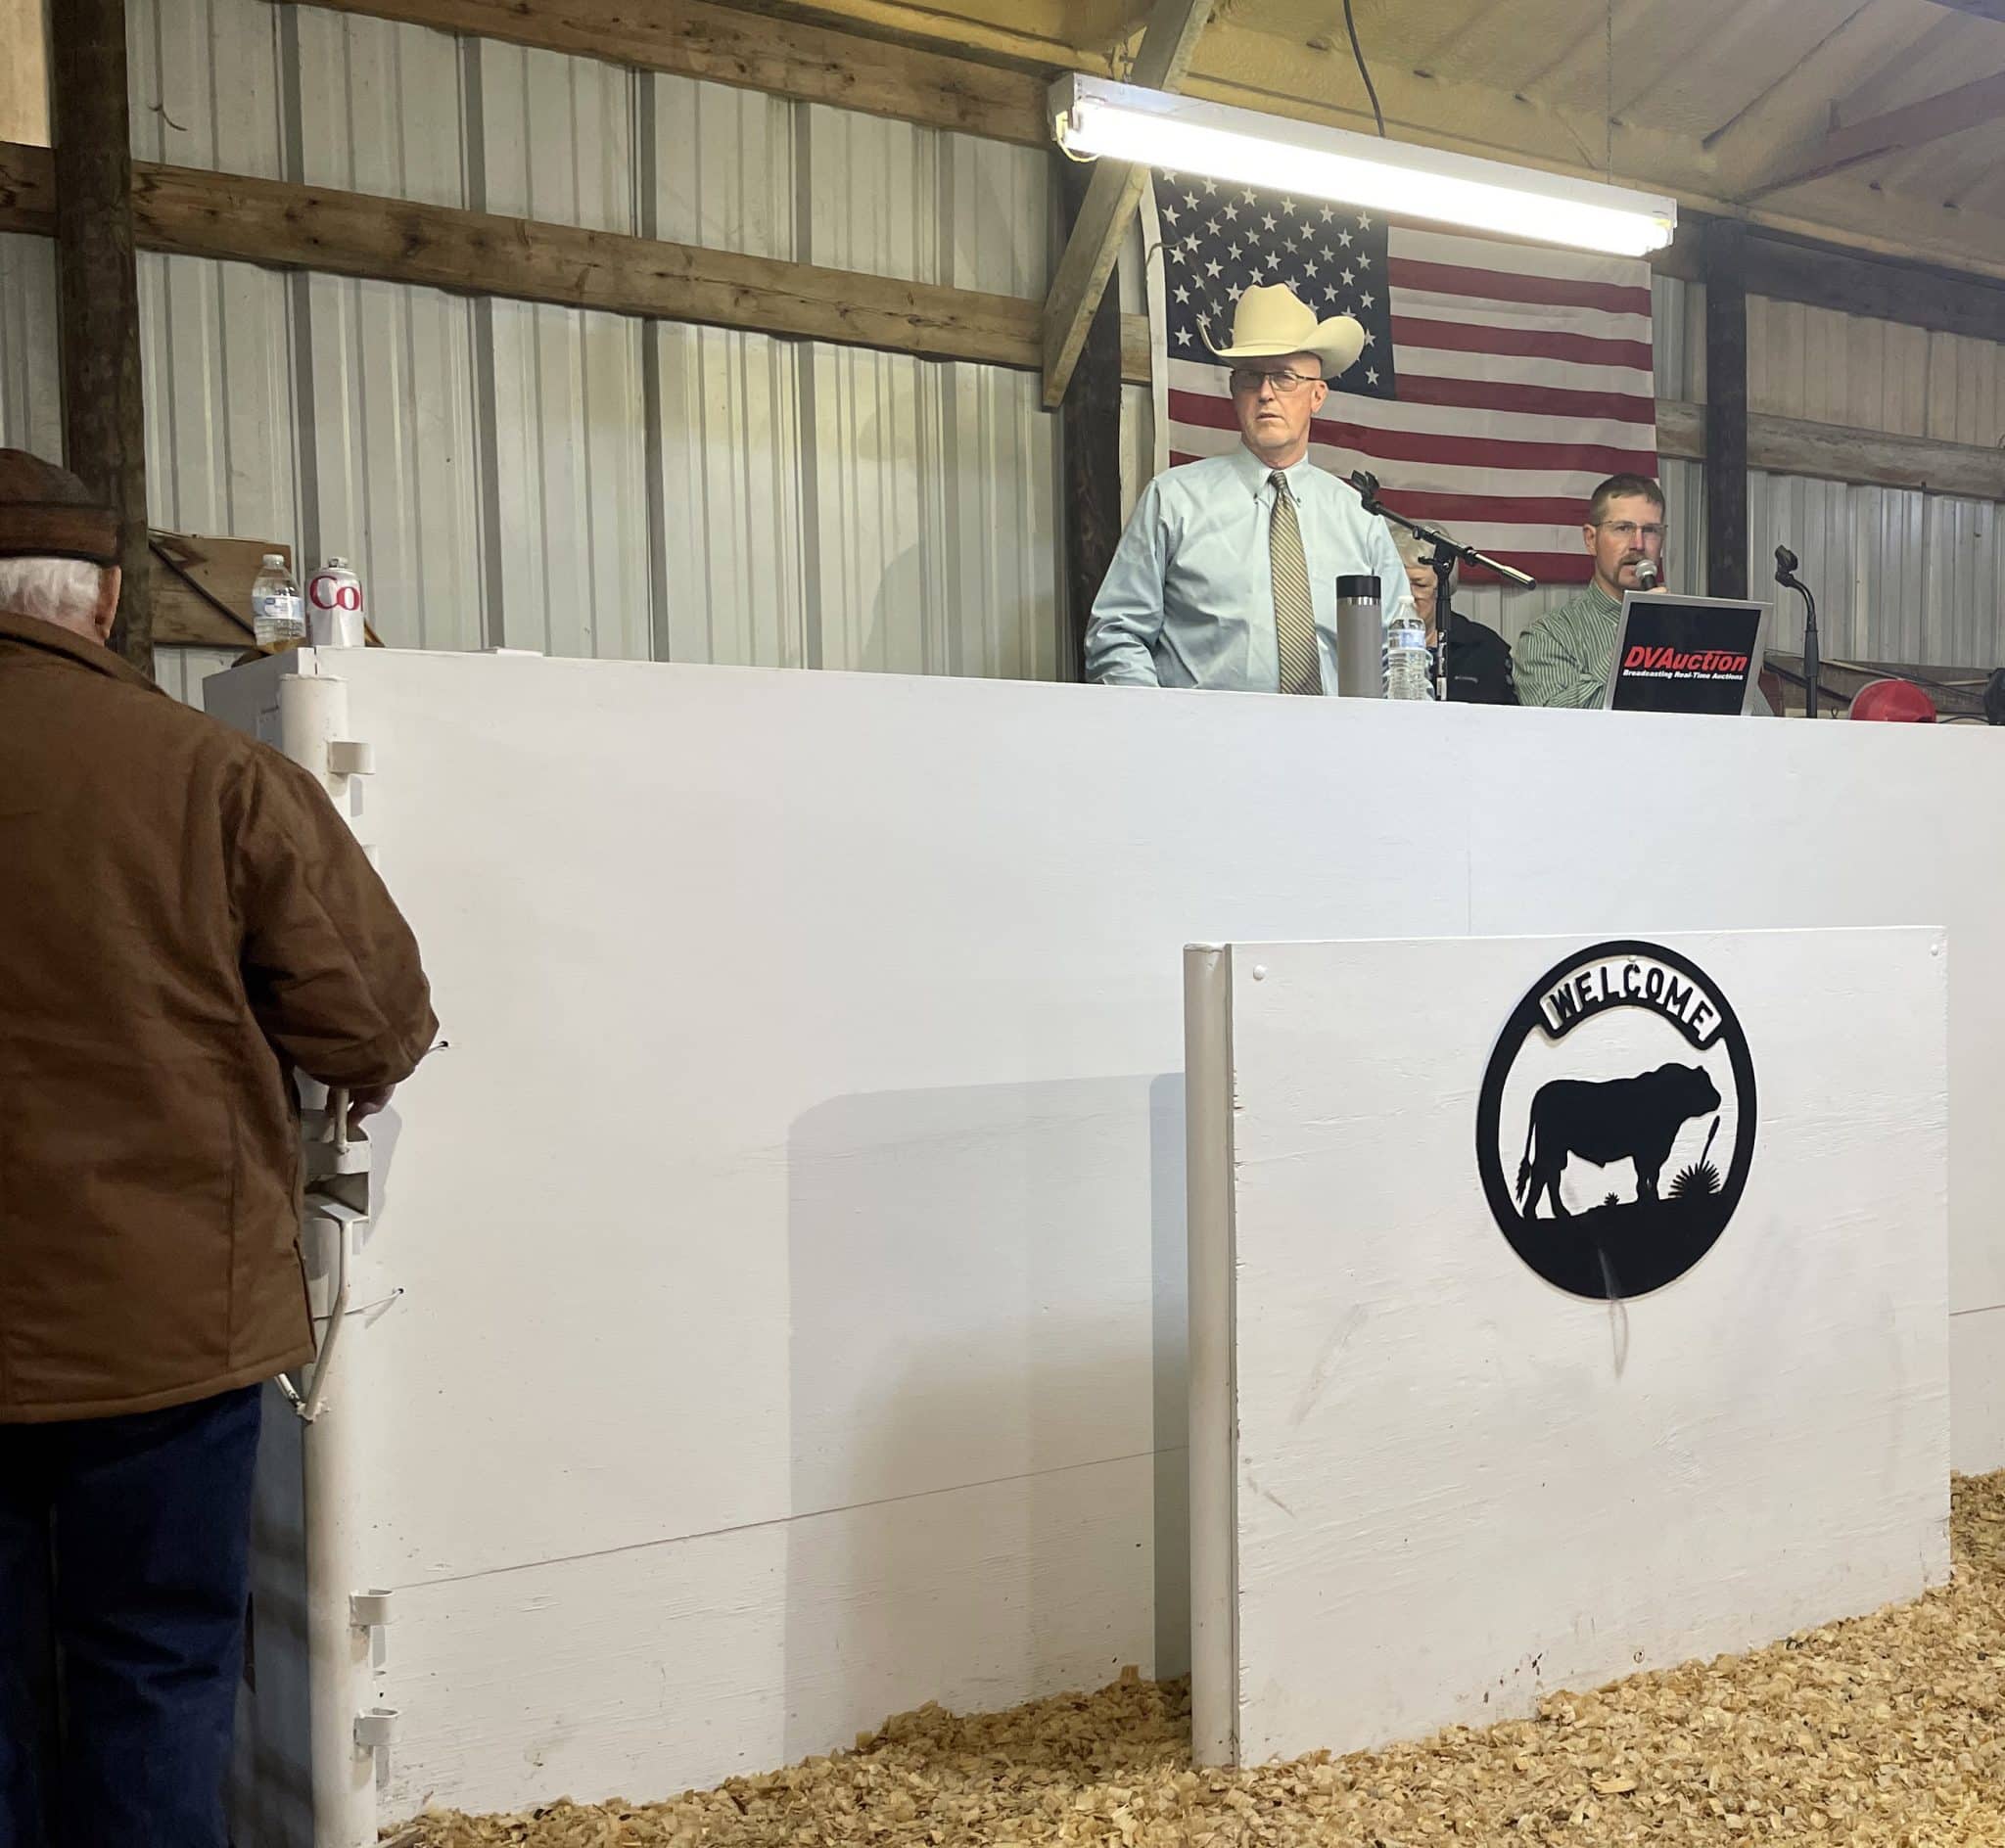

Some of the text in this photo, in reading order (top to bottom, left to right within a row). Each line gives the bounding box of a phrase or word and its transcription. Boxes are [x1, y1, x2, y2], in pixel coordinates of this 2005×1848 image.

[309, 575, 363, 612] Co
[1624, 646, 1748, 671] DVAuction
[1622, 669, 1673, 679] Broadcasting
[1711, 672, 1744, 681] Auctions
[1543, 963, 1718, 1036] WELCOME
